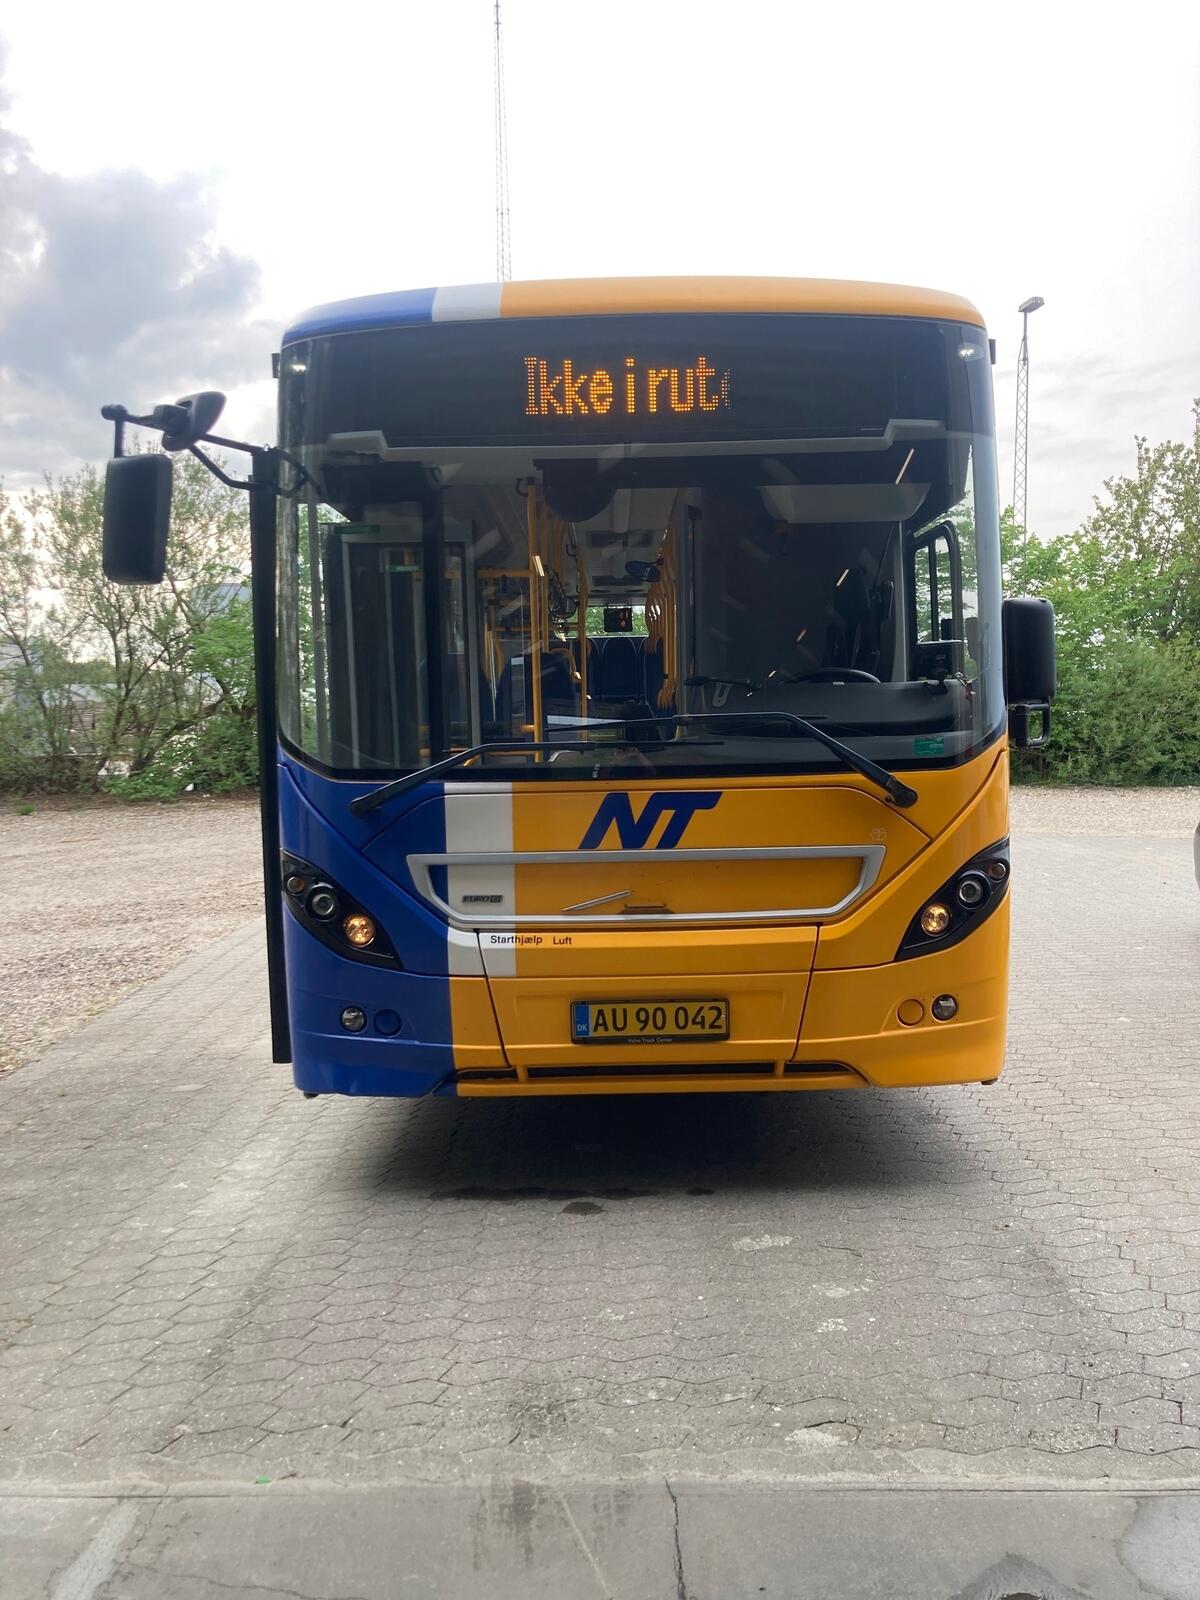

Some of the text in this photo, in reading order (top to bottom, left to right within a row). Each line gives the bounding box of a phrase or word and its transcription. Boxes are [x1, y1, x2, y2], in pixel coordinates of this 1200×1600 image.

[524, 357, 613, 414] Ikke
[626, 358, 635, 413] i
[578, 791, 723, 849] NT
[490, 934, 572, 946] Starthjælp Luft
[577, 1024, 588, 1032] DK
[593, 1005, 723, 1032] AU 90 042
